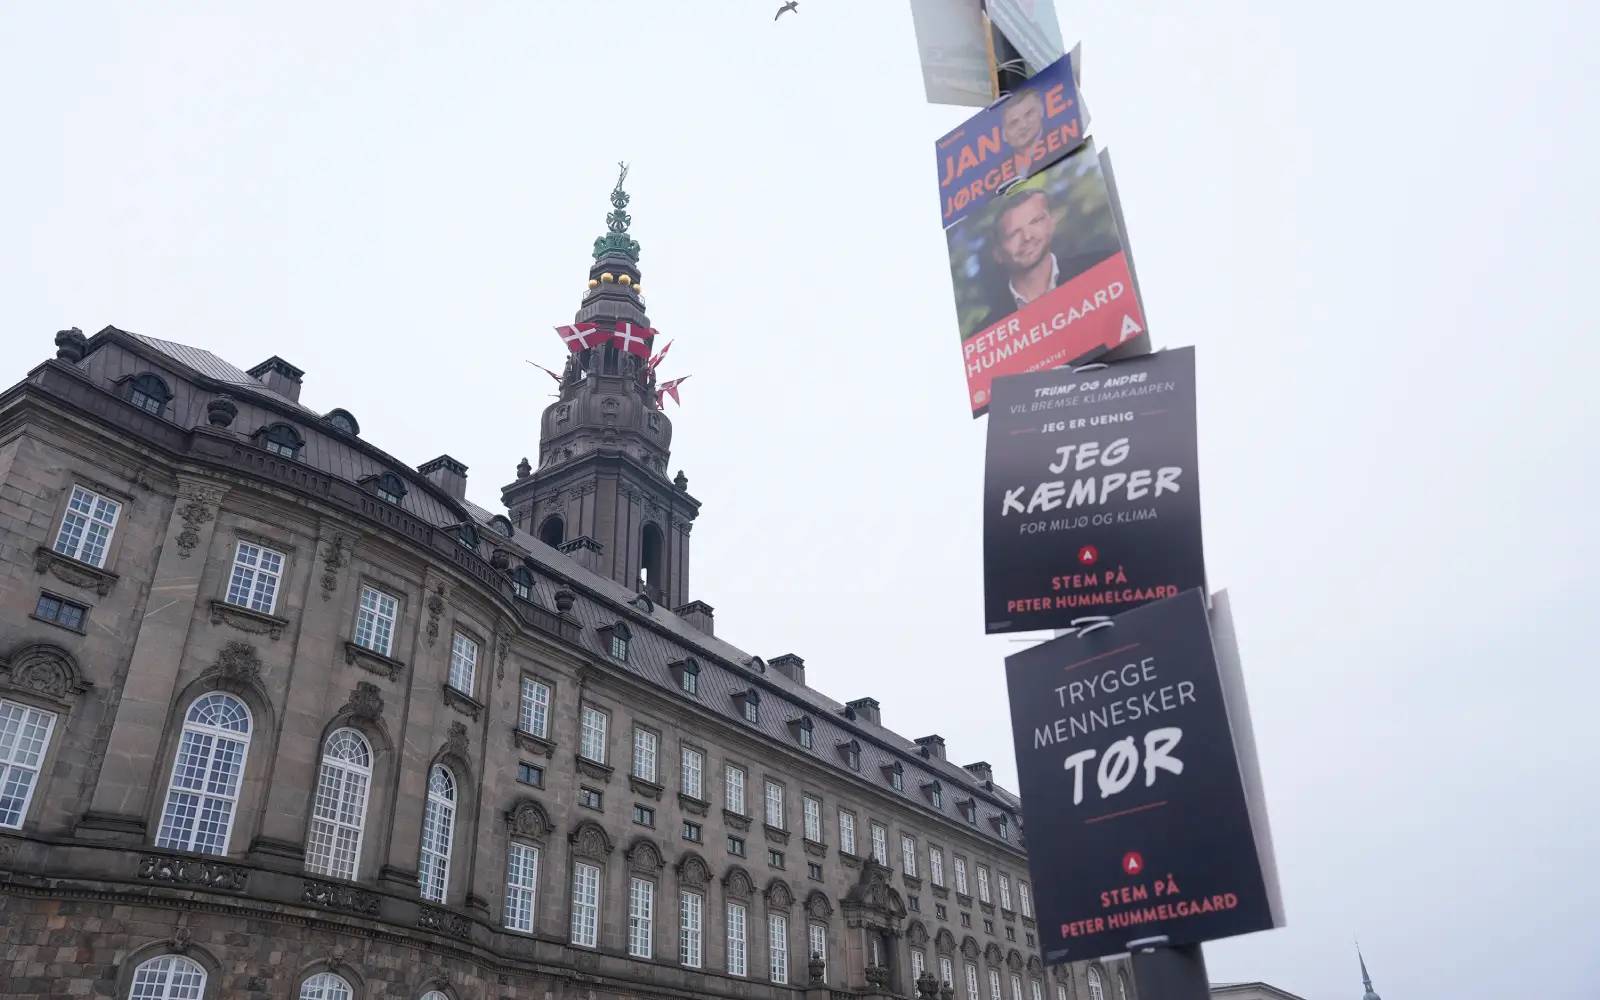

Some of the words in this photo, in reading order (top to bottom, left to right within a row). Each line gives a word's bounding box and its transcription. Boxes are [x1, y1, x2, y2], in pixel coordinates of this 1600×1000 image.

[941, 125, 1003, 187] JAN
[1045, 83, 1074, 118] E.
[943, 119, 1080, 218] JØRGENSEN
[964, 317, 1021, 360] PETER
[967, 281, 1125, 378] HUMMELGAARD
[1119, 314, 1142, 343] A
[1009, 403, 1027, 414] VIL
[1031, 395, 1080, 412] BREMSE
[1083, 382, 1176, 403] KLIMAKAMPEN
[1034, 382, 1076, 398] TRUMP
[1080, 380, 1100, 392] OG
[1104, 372, 1148, 388] ANDRE
[1041, 421, 1065, 434] JEG
[1069, 417, 1086, 429] ER
[1090, 411, 1134, 426] UENIG
[1048, 437, 1131, 475] JEG
[1001, 466, 1183, 517] KÆMPER
[1019, 521, 1047, 535] FOR
[1049, 516, 1089, 531] MILJØ
[1092, 512, 1113, 526] OG
[1117, 507, 1158, 523] KLIMA
[1083, 550, 1093, 560] A
[1052, 573, 1098, 590] STEM
[1105, 565, 1127, 585] PÅ
[1007, 596, 1052, 613] PETER
[1056, 585, 1178, 609] HUMMELGAARD
[1055, 657, 1157, 708] TRYGGE
[1034, 680, 1196, 749] MENNESKER
[1064, 727, 1184, 806] TØR
[1128, 857, 1139, 870] A
[1101, 884, 1148, 908] STEM
[1154, 873, 1180, 896] PÅ
[1061, 916, 1105, 938] PETER
[1108, 893, 1239, 930] HUMMELGAARD
